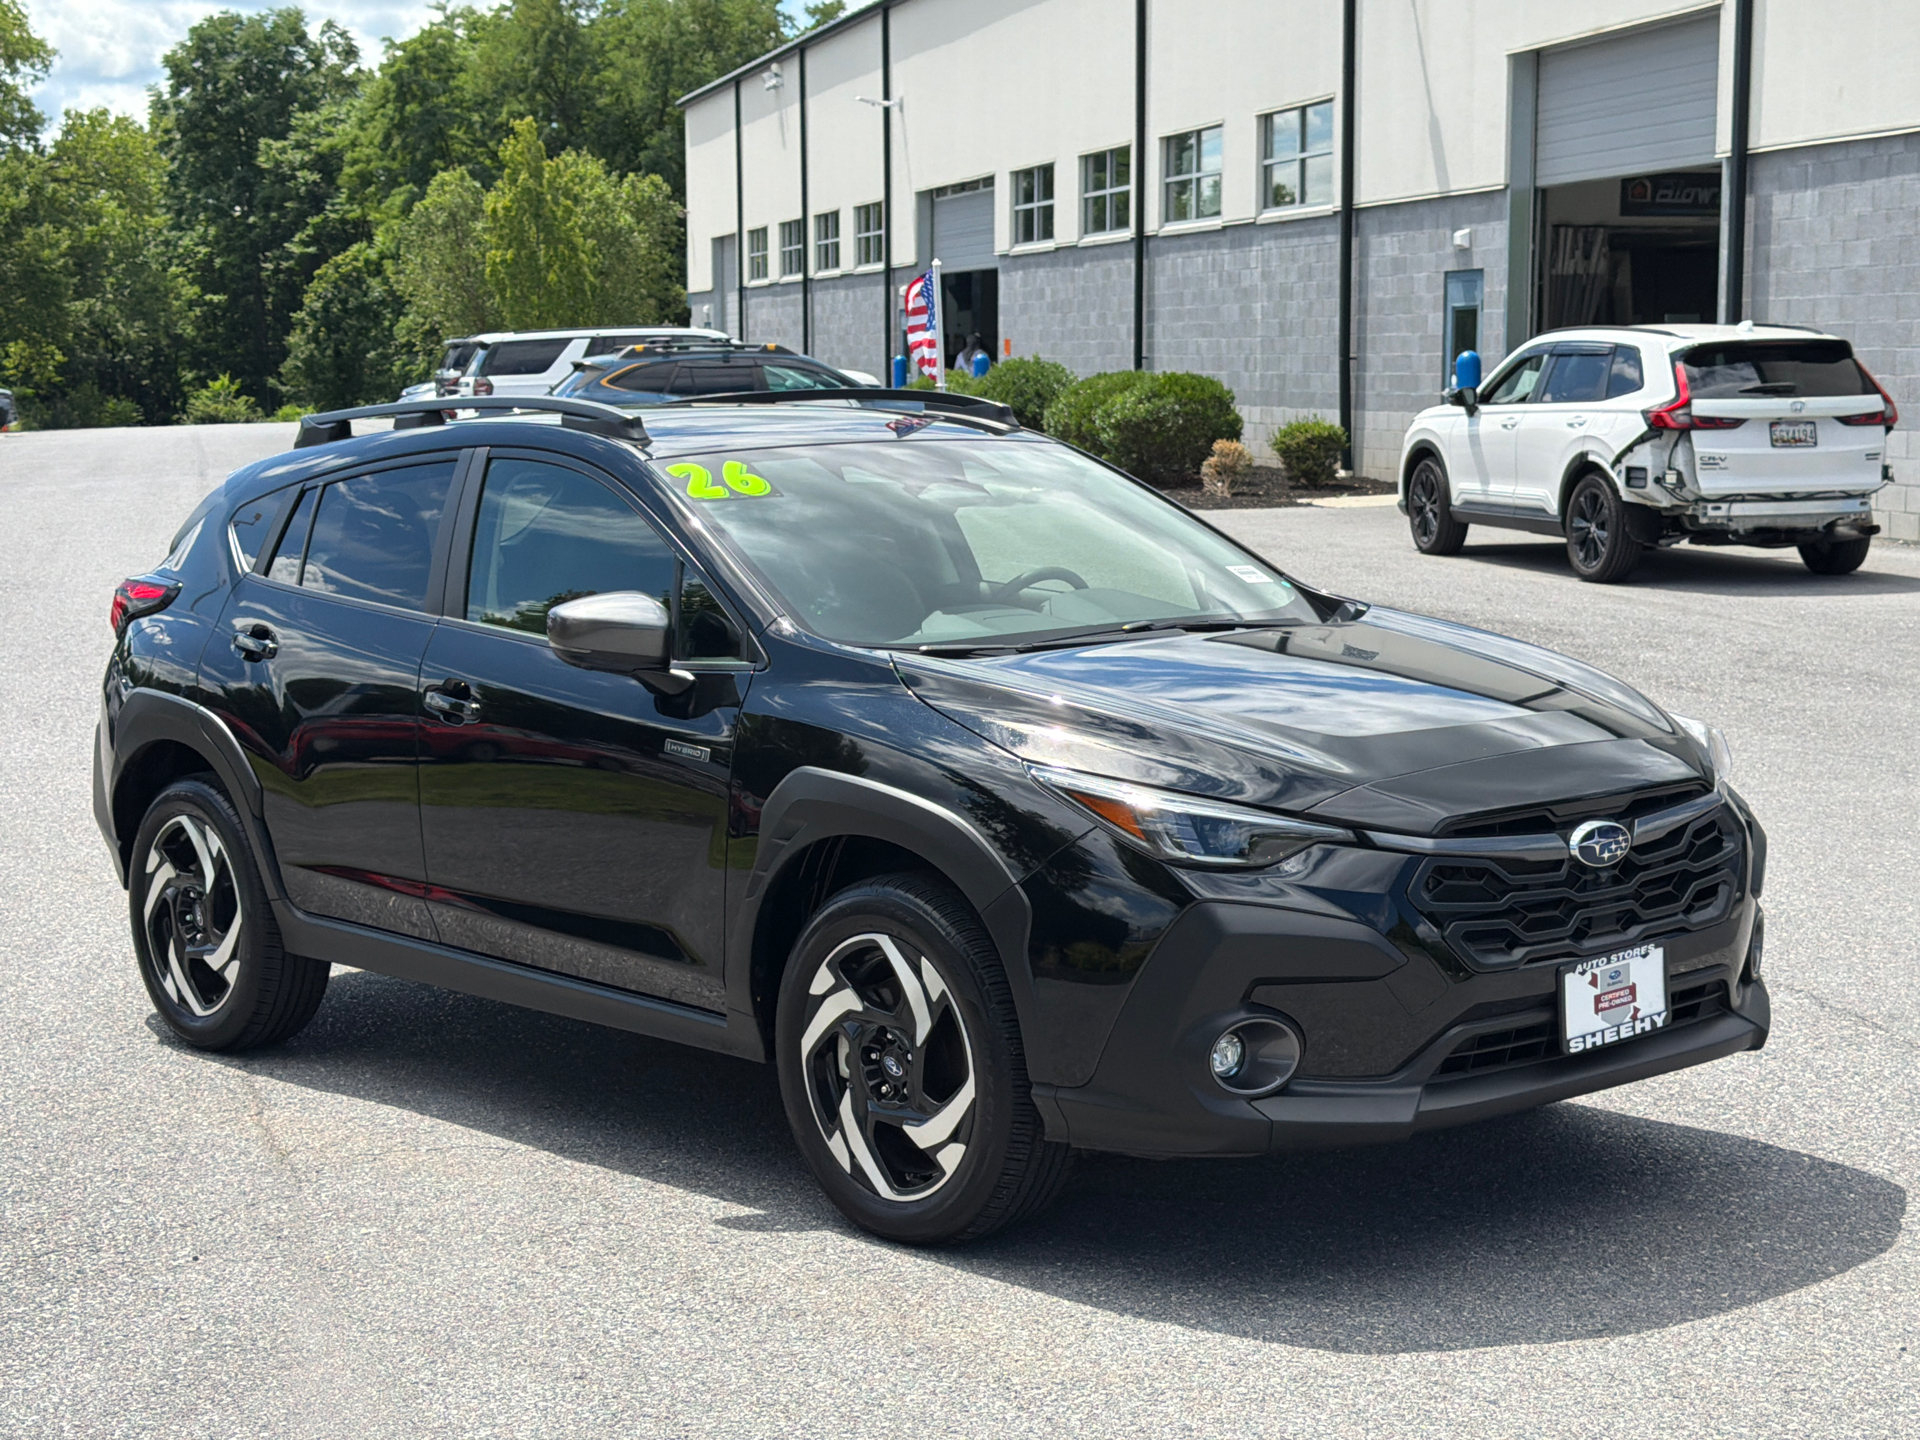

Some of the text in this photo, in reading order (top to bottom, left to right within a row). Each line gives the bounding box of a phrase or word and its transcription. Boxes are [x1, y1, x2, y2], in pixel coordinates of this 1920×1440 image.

[665, 460, 772, 499] 26
[670, 744, 701, 757] HYBRID
[1574, 943, 1656, 975] AUTO STORES
[1598, 995, 1633, 1010] PRE-OWNED
[1600, 988, 1630, 1002] CERTIFIED
[1569, 1011, 1668, 1053] SHEEHY
